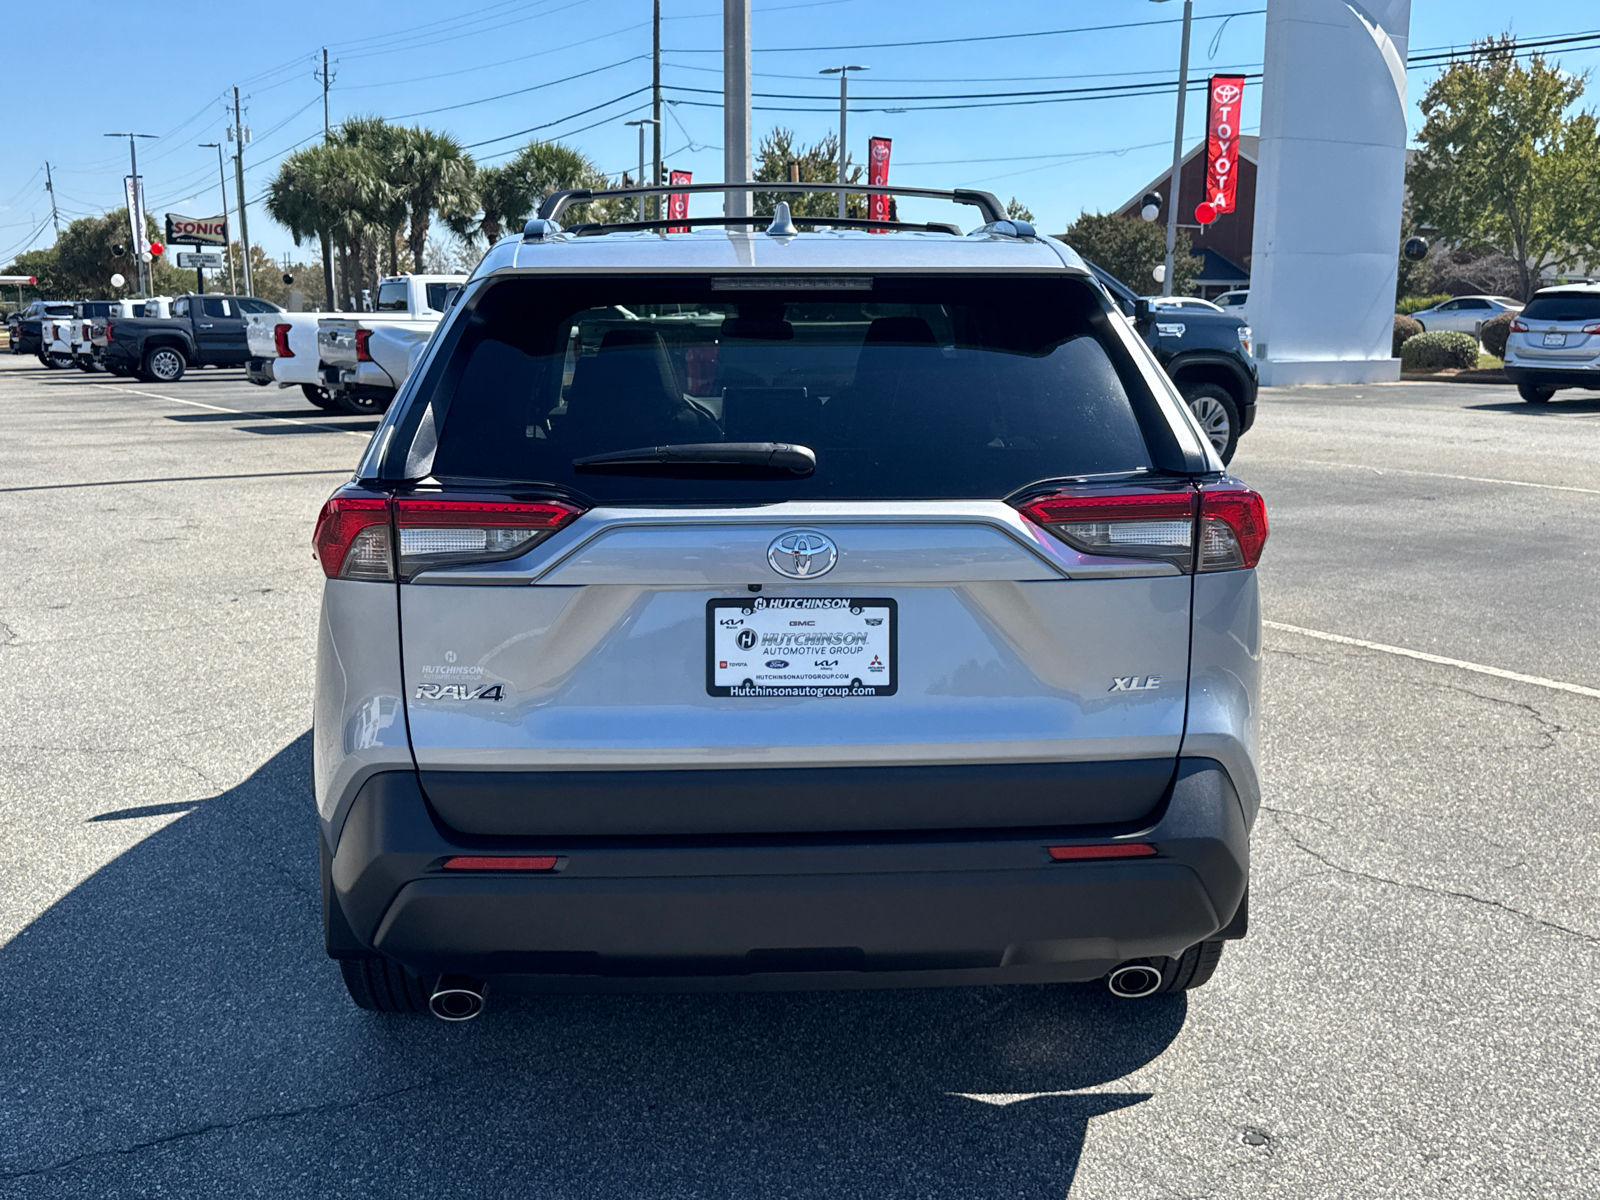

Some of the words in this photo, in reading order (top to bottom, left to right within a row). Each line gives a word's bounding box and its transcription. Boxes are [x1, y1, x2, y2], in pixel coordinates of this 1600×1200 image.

[1213, 106, 1232, 208] TOYOTA
[174, 221, 223, 235] SONIC
[769, 598, 851, 610] HUTCHINSON
[761, 632, 868, 647] HUTCHINSON
[762, 647, 827, 656] AUTOMOTIVE
[829, 646, 864, 655] GROUP
[422, 665, 484, 675] HUTCHINSON
[755, 673, 850, 681] HUTCHINSONAUTOGROUP.COM
[1108, 675, 1162, 691] XLE
[415, 683, 506, 702] RAV4
[730, 686, 876, 698] Hutchinsonautogroup.com
